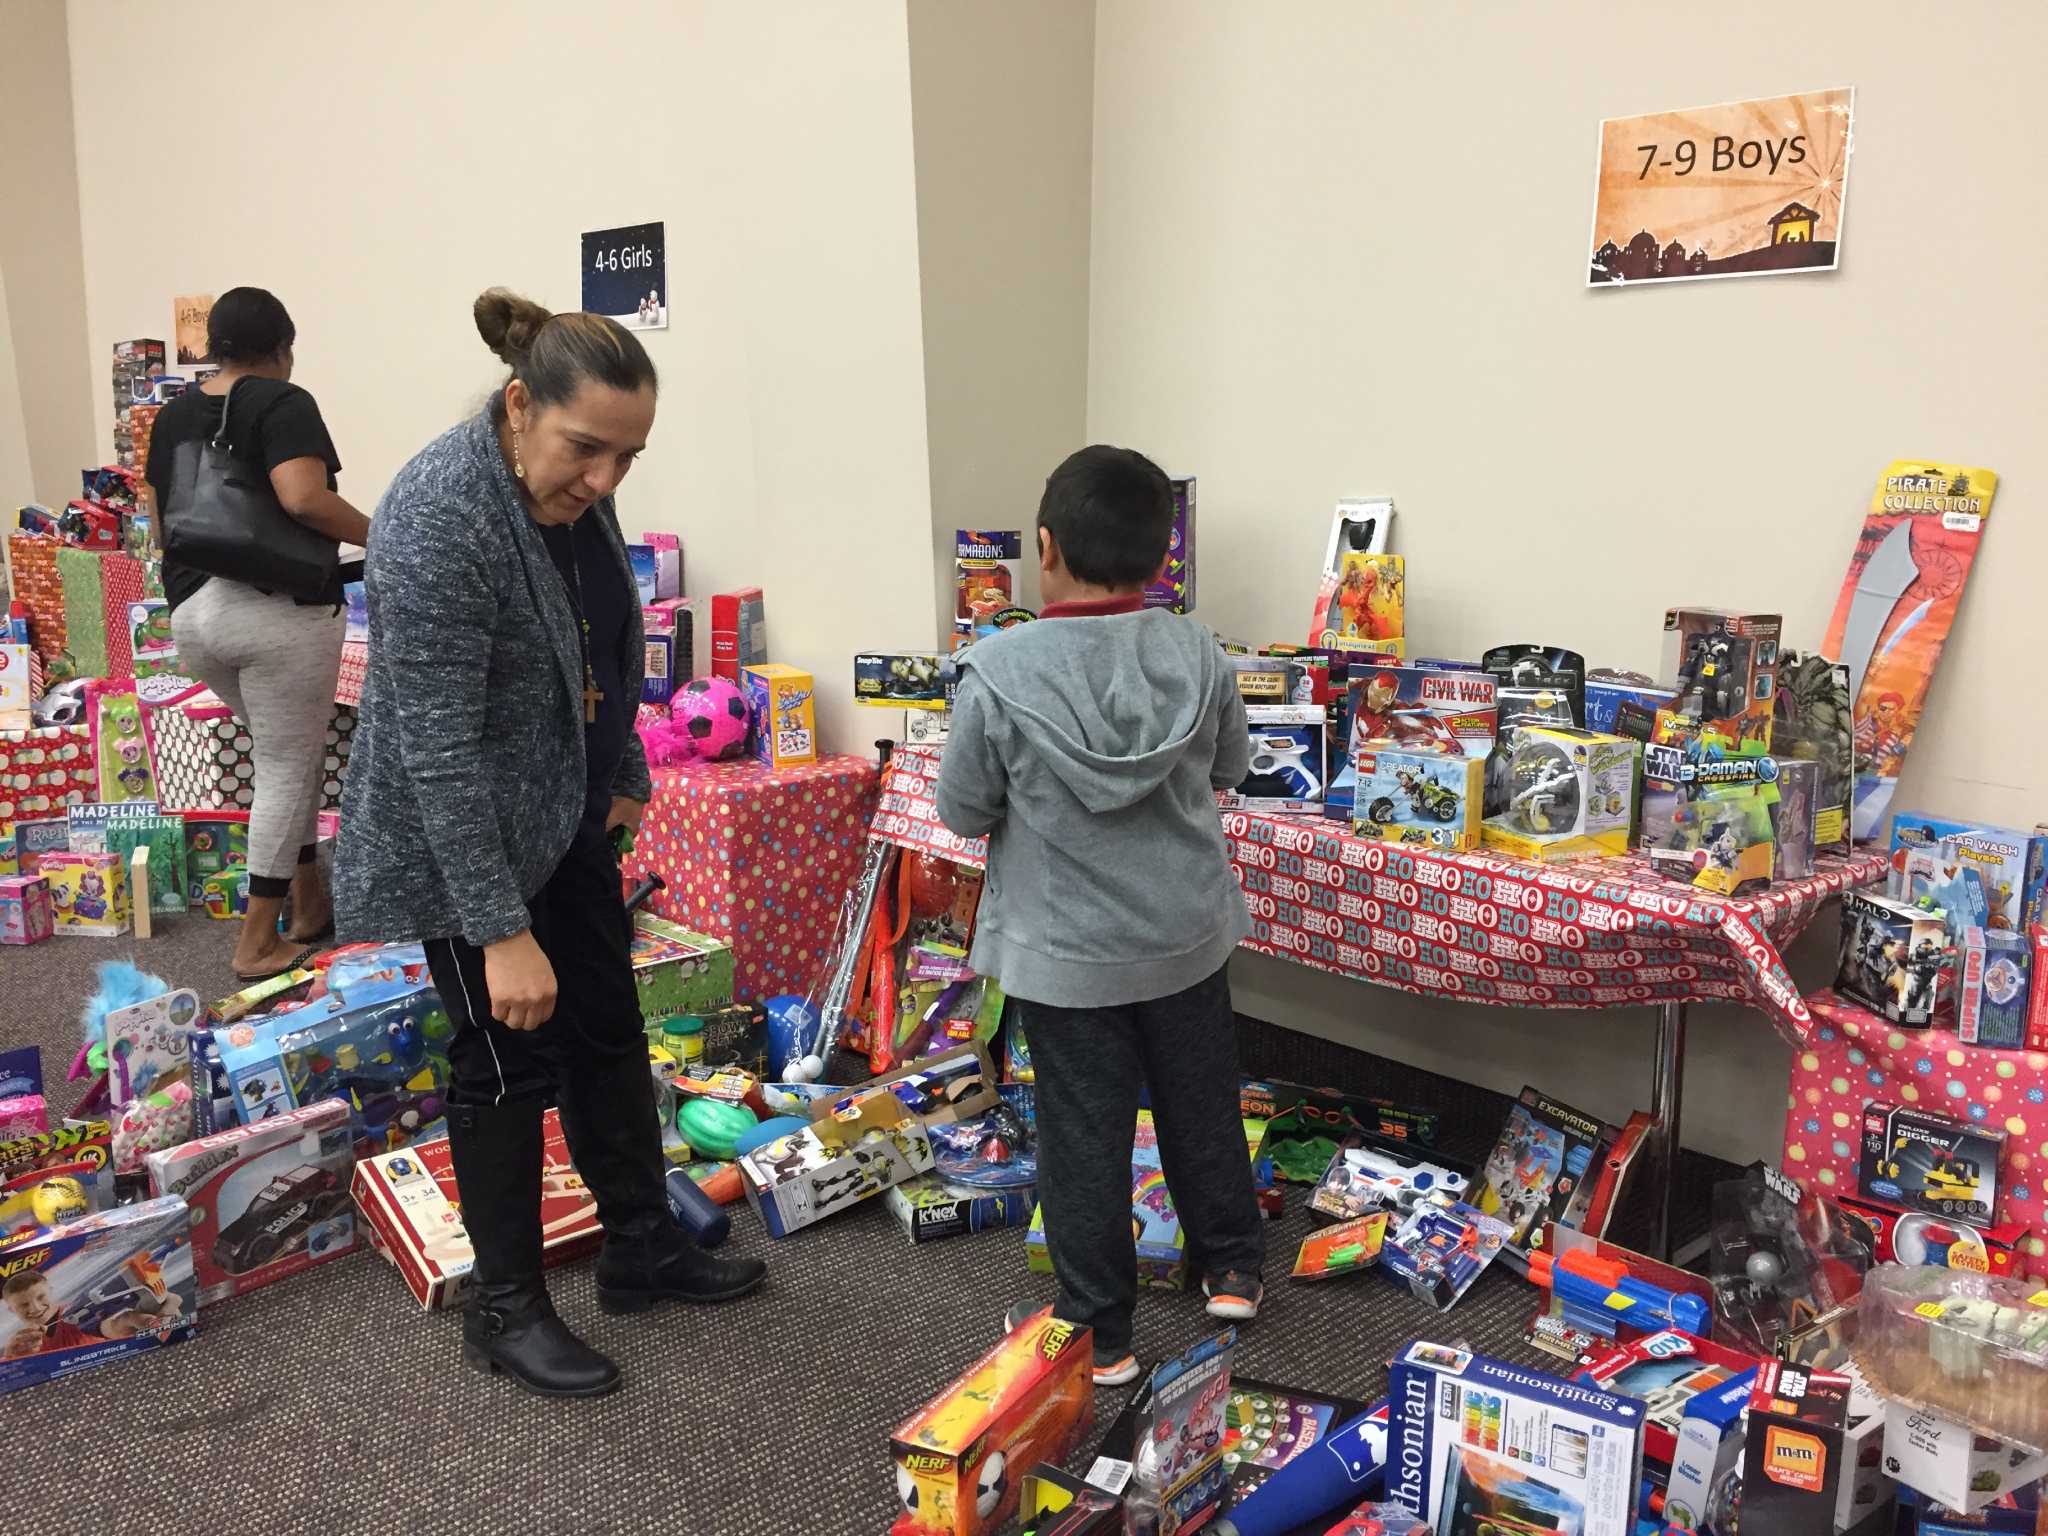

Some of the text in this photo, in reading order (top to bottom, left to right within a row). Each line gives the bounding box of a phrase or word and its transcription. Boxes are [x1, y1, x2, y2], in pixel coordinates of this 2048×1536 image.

[1636, 134, 1807, 181] 7-9 Boys
[595, 243, 653, 272] 4-6 Girls
[1886, 477, 1947, 494] PIRATE
[1884, 494, 1981, 513] COLLECTION
[1423, 677, 1494, 704] CIVIL WAR
[70, 804, 157, 820] MADELINE
[106, 817, 183, 831] MADELINE
[1945, 833, 1975, 848] CAR
[1977, 839, 2019, 857] WASH
[1958, 847, 2004, 866] Playset
[1248, 818, 1634, 932] HO HO HO HO HO HO HO HO HO HO
[1236, 840, 1584, 948] HO HO HO HO HO HO HO HO HO
[1592, 885, 1688, 916] HO HO
[1245, 867, 1580, 968] HO HO HO HO HO HO HO HO HO
[1853, 897, 1892, 921] HALO
[1277, 900, 1594, 986] HO HO HO HO HO HO HO HO
[1270, 923, 1552, 1001] HO HO HO HO HO HO HO
[1721, 913, 1812, 1021] HO HO
[1967, 950, 1982, 984] UFO
[1961, 986, 1979, 1041] SUPER
[1379, 1121, 1408, 1138] 35
[1538, 1101, 1598, 1136] EXCAVATOR
[1897, 1124, 1931, 1135] DELUXE
[1865, 1140, 1882, 1150] 110
[1896, 1129, 1950, 1147] DIGGER
[401, 1194, 416, 1203] 3+
[422, 1187, 436, 1197] 34
[265, 1202, 308, 1234] POLICE
[1043, 1321, 1075, 1361] NERF
[1651, 1334, 1687, 1356] KID
[1482, 1364, 1617, 1412] Smithsonian
[1778, 1370, 1791, 1398] WARS
[1791, 1371, 1808, 1398] STAR
[1442, 1384, 1453, 1418] STEM
[1905, 1415, 1943, 1442] Ford
[905, 1454, 951, 1470] NERF
[963, 1434, 987, 1474] NERF
